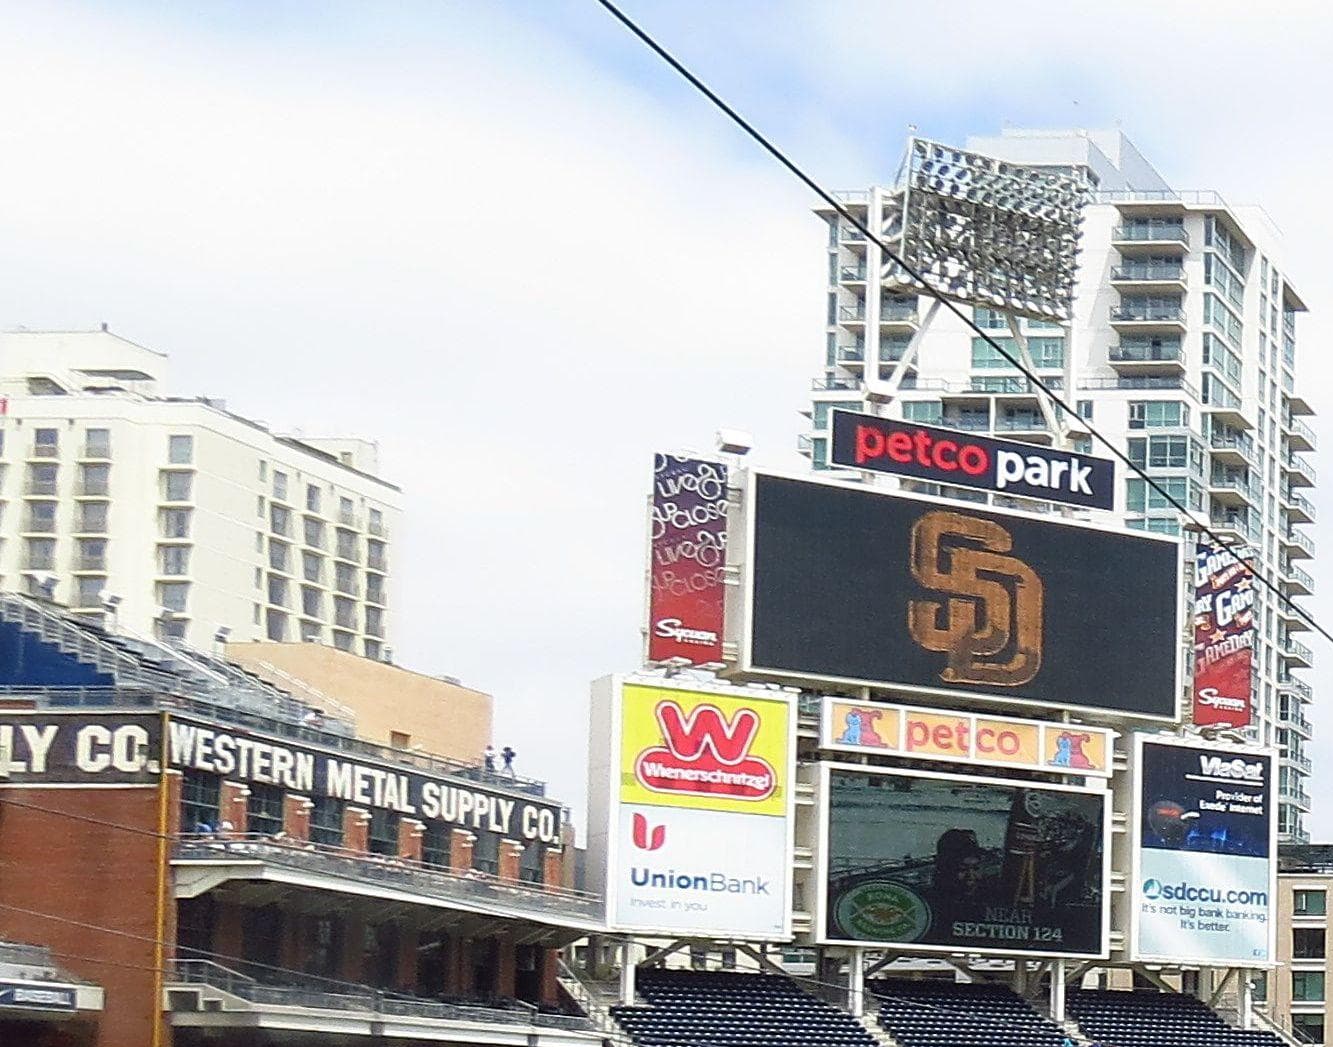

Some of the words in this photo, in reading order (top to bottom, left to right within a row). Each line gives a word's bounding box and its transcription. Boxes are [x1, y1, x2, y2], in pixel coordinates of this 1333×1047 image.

[855, 423, 992, 476] petco
[995, 448, 1094, 496] park
[75, 724, 161, 774] CO.
[906, 718, 1021, 755] petco
[169, 720, 314, 792] WESTERN
[326, 758, 417, 815] METAL
[421, 781, 515, 834] SUPPLY
[522, 804, 560, 844] CO.
[631, 867, 770, 895] UnionBank
[1162, 881, 1268, 907] sdccu.com
[684, 900, 708, 912] you
[1159, 904, 1177, 916] not
[1179, 906, 1196, 919] big
[1198, 907, 1224, 919] bank
[952, 920, 1029, 940] SECTION
[1033, 926, 1063, 943] 124
